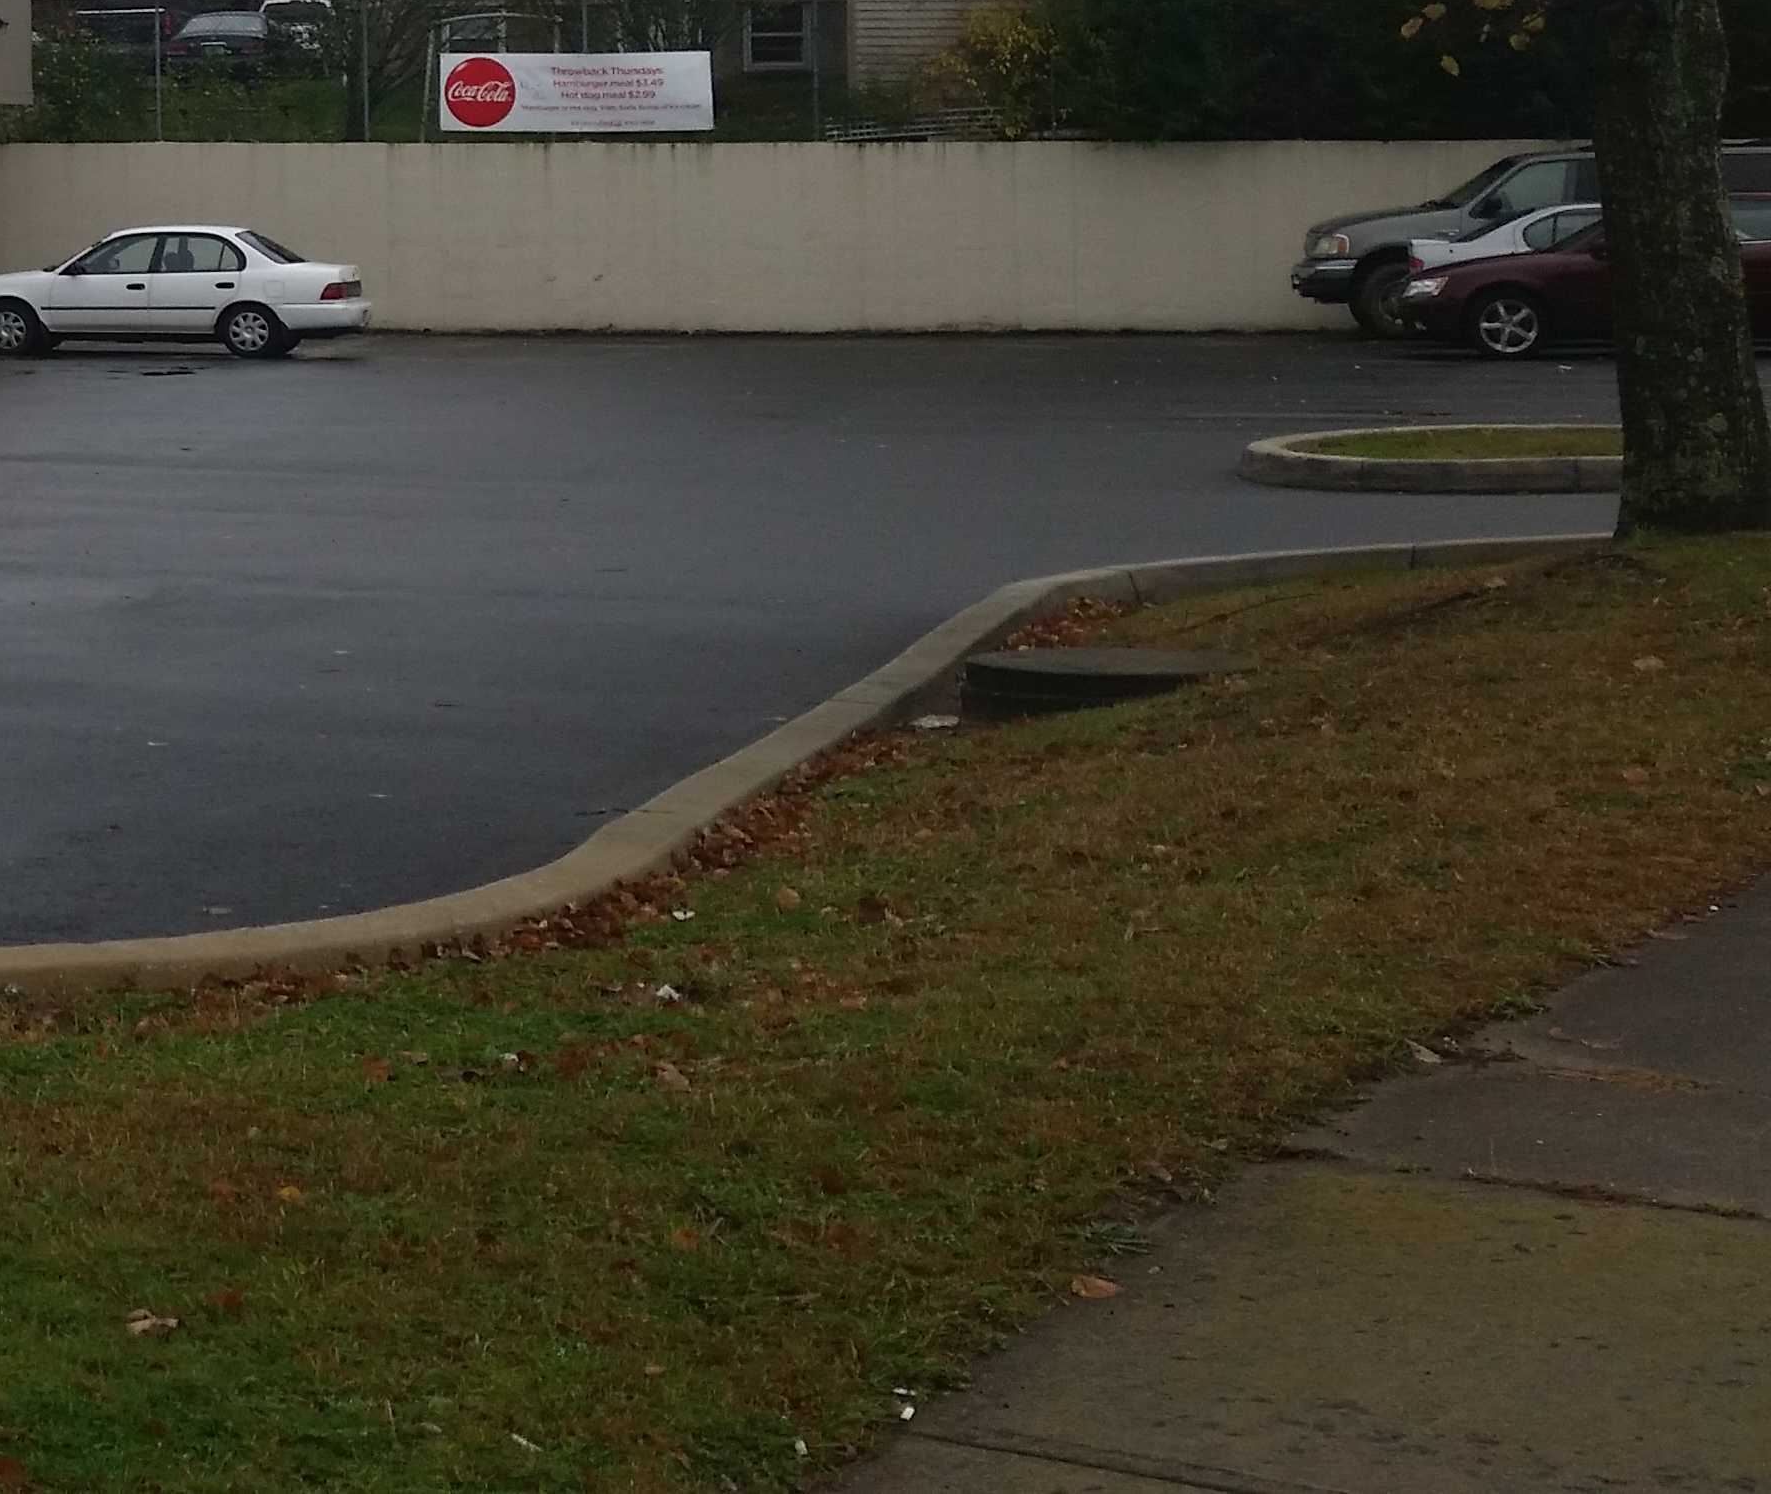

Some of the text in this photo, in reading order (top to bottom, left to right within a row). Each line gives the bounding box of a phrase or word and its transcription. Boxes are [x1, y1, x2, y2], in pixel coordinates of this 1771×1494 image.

[551, 66, 609, 76] Throwback
[553, 80, 608, 89] Hamburger
[610, 79, 635, 87] meal
[448, 80, 511, 102] Coca-Cola
[561, 91, 579, 99] Hot
[580, 92, 601, 101] dog
[602, 91, 627, 99] meal
